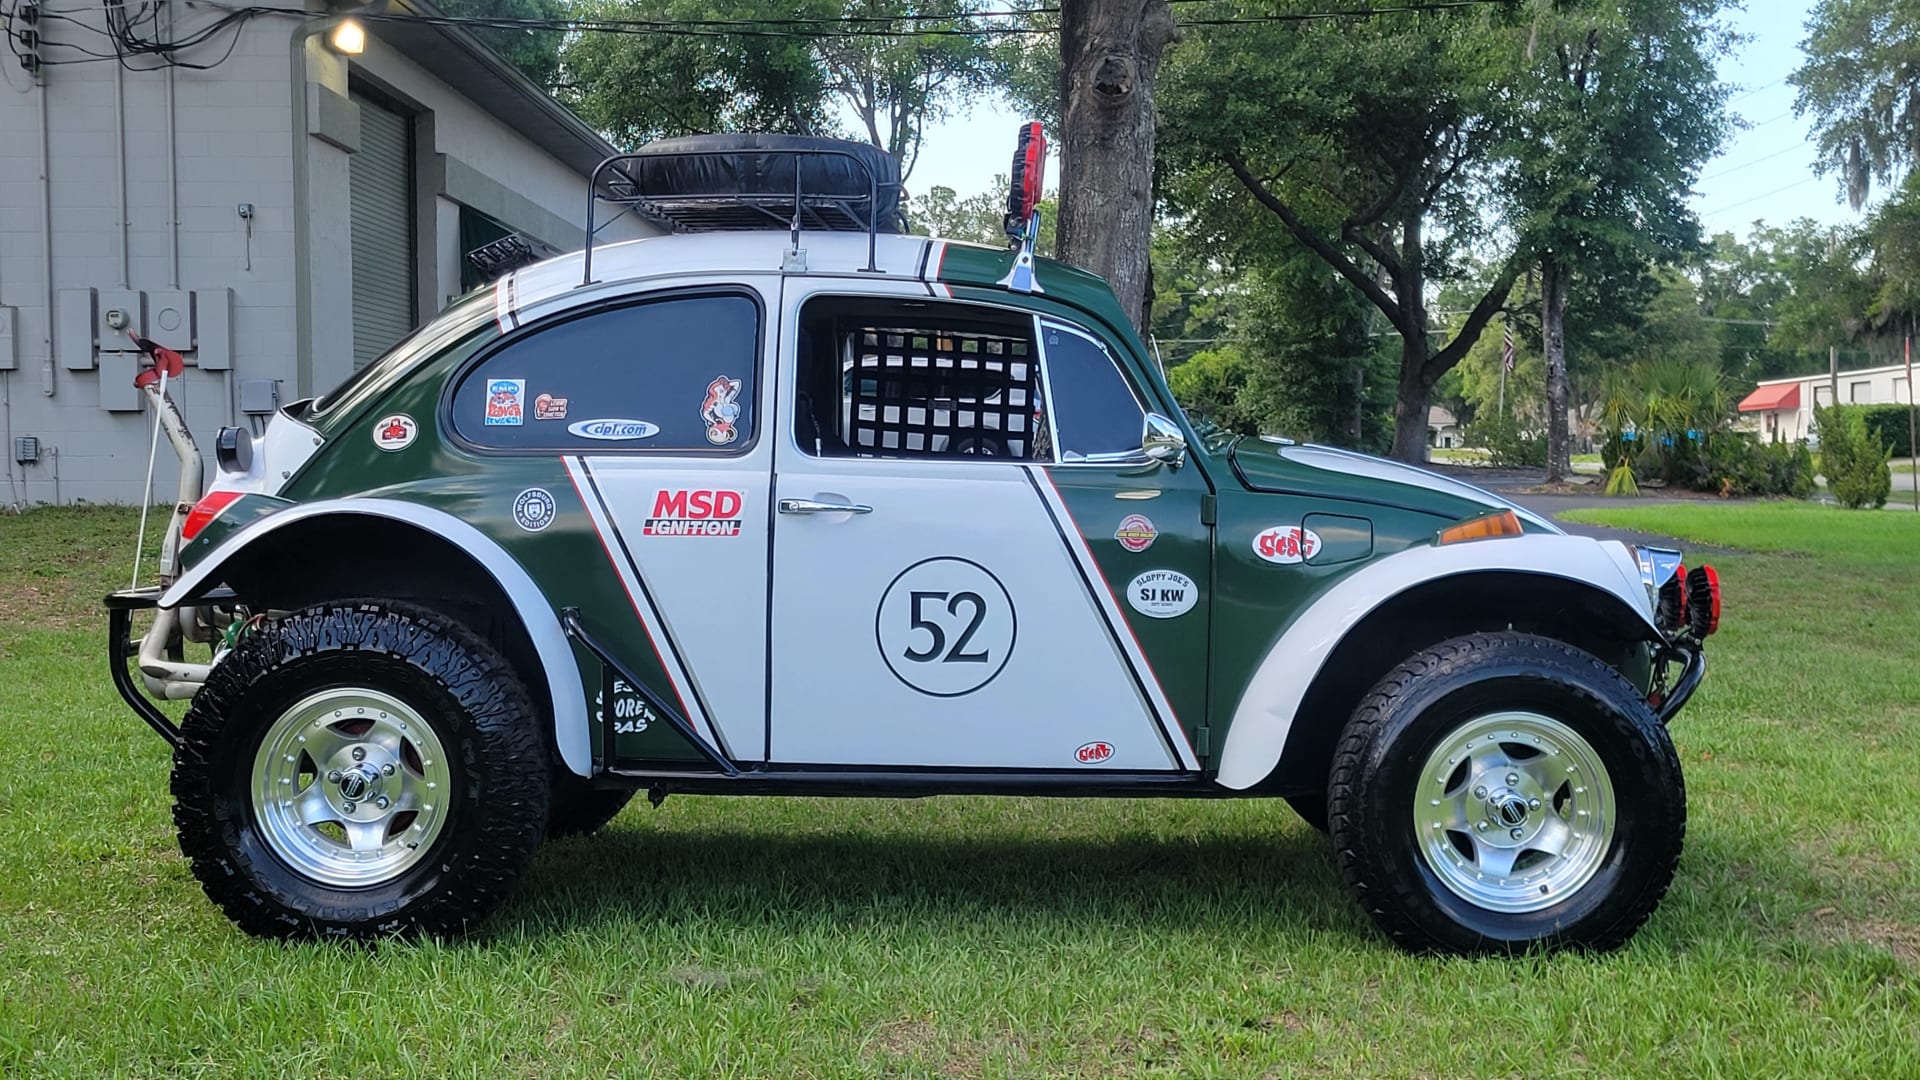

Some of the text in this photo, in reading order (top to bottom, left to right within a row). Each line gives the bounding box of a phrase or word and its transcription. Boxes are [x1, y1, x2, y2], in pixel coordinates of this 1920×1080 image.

[516, 491, 552, 511] WOLFSBURG
[652, 490, 742, 519] MSD
[520, 515, 549, 528] EDITION
[651, 520, 735, 535] IGNITION
[1136, 573, 1190, 588] SLOPPY JOE'S
[1140, 588, 1184, 602] SJ KW
[903, 591, 989, 663] 52
